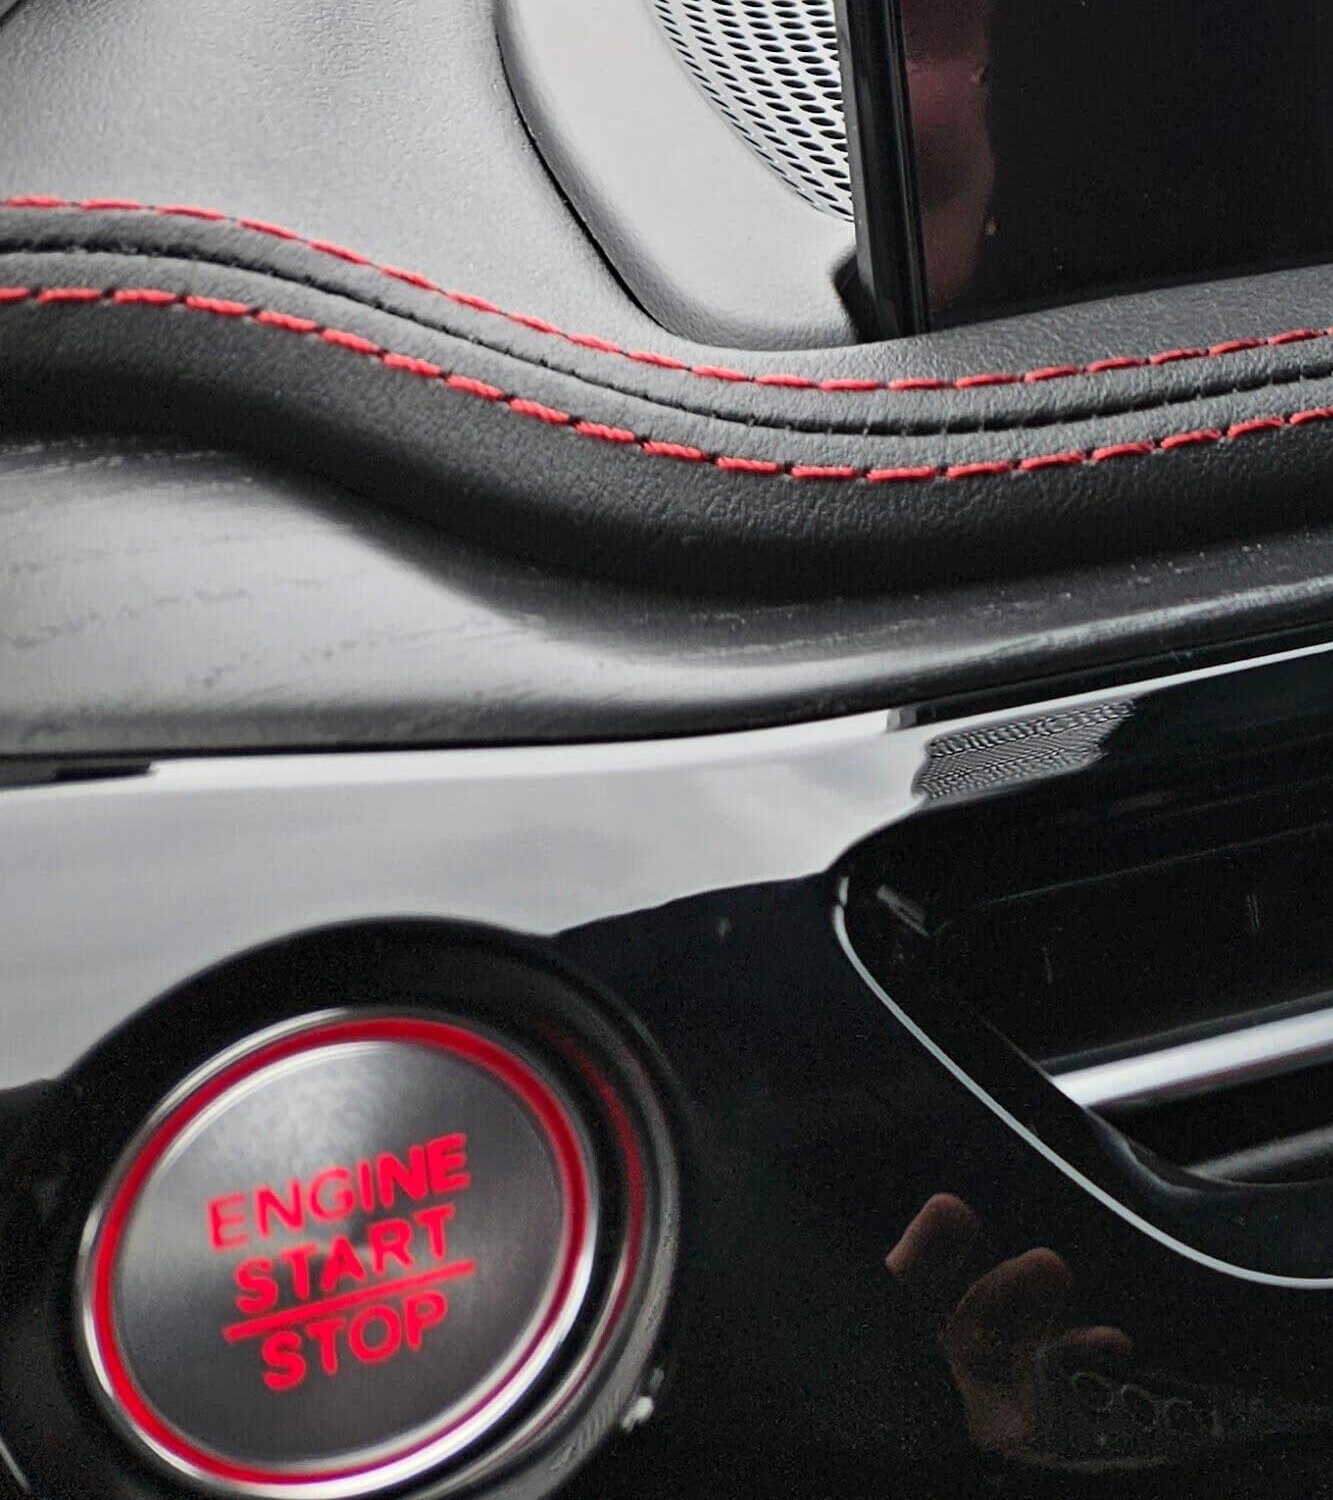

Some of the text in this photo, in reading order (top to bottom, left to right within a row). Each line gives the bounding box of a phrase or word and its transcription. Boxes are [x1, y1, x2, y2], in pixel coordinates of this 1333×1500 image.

[208, 1132, 470, 1250] ENGINE
[234, 1205, 455, 1314] START
[261, 1293, 448, 1390] STOP
